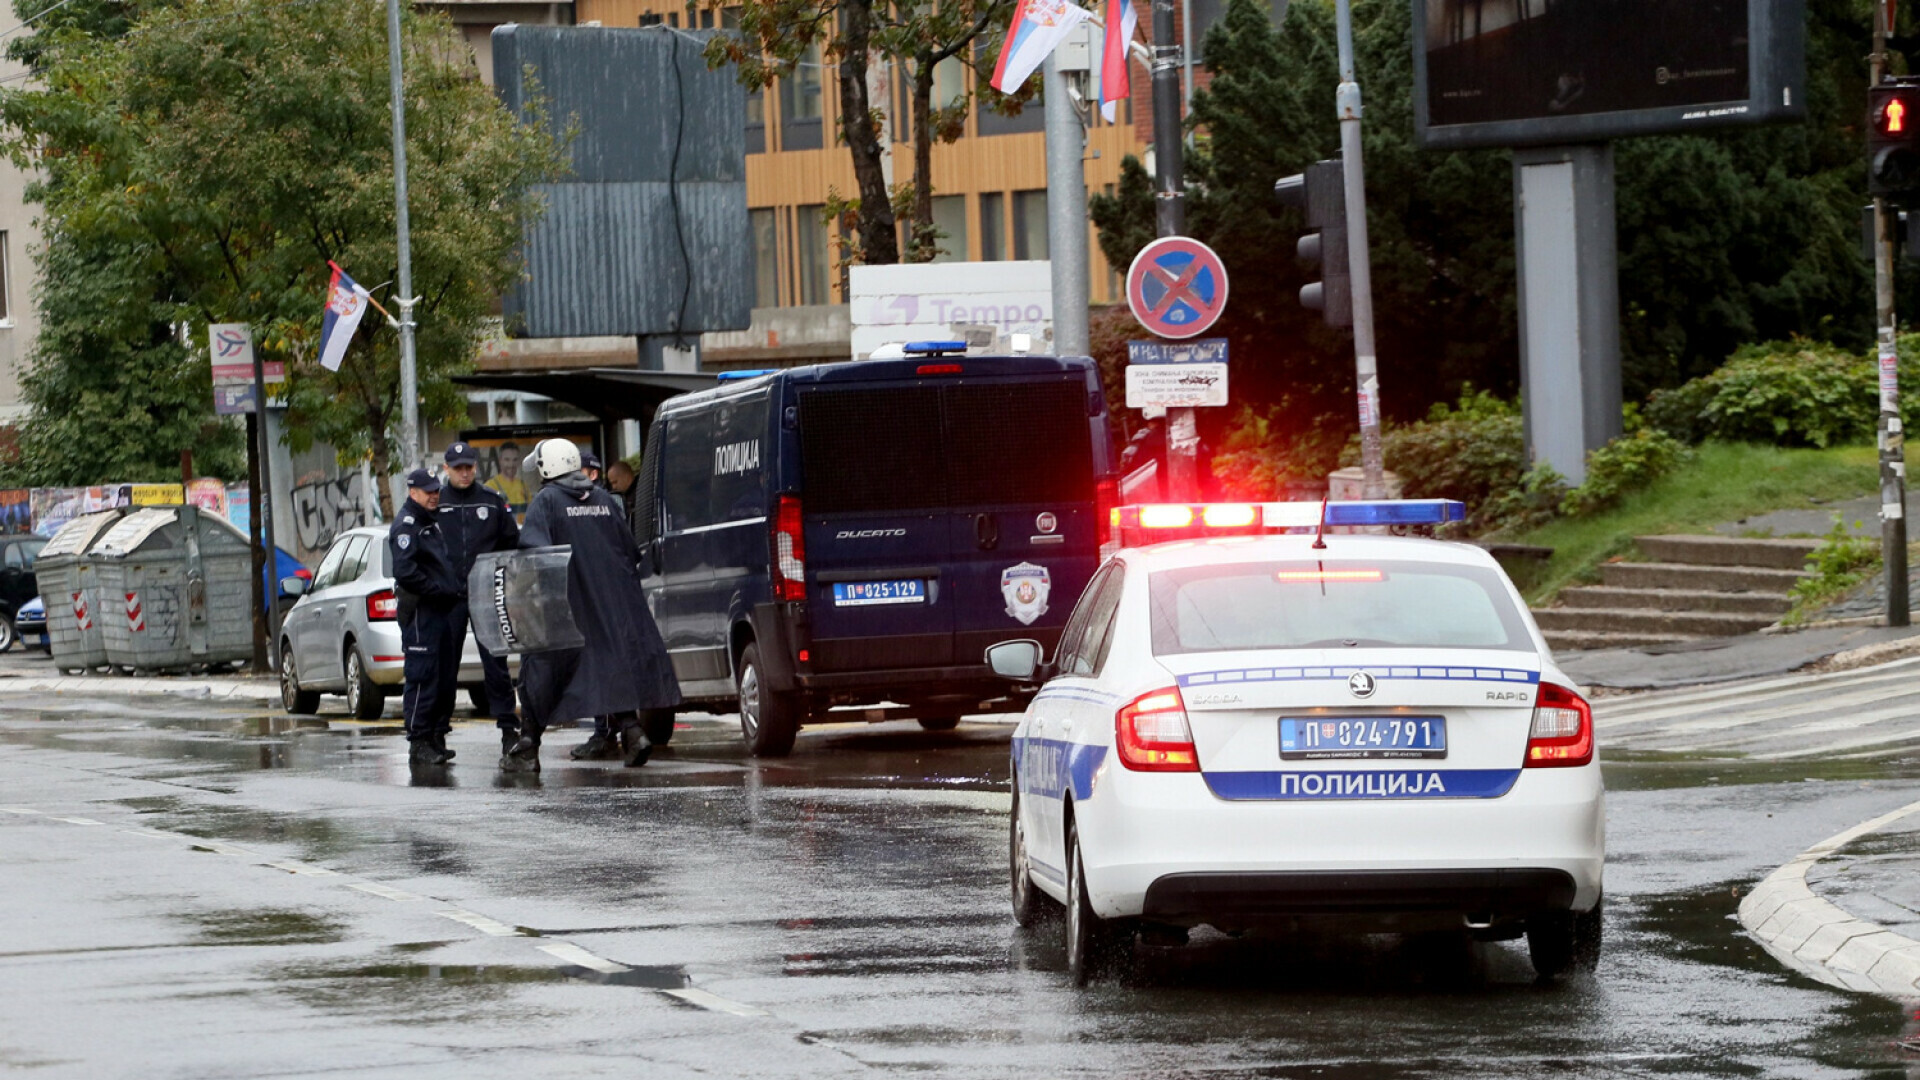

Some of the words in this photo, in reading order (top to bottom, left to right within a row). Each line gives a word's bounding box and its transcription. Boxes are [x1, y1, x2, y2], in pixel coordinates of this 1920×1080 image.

[930, 300, 1043, 332] Tempo
[714, 439, 760, 477] ПОЛИЦИЈА
[566, 505, 610, 517] ПОЛИЦИЈА
[836, 528, 906, 539] DUCATO
[494, 567, 516, 643] ПОЛИЦИЈА
[1486, 691, 1528, 701] RAPID
[1306, 722, 1320, 746] П
[1280, 772, 1446, 796] ПОЛИЦИЈА
